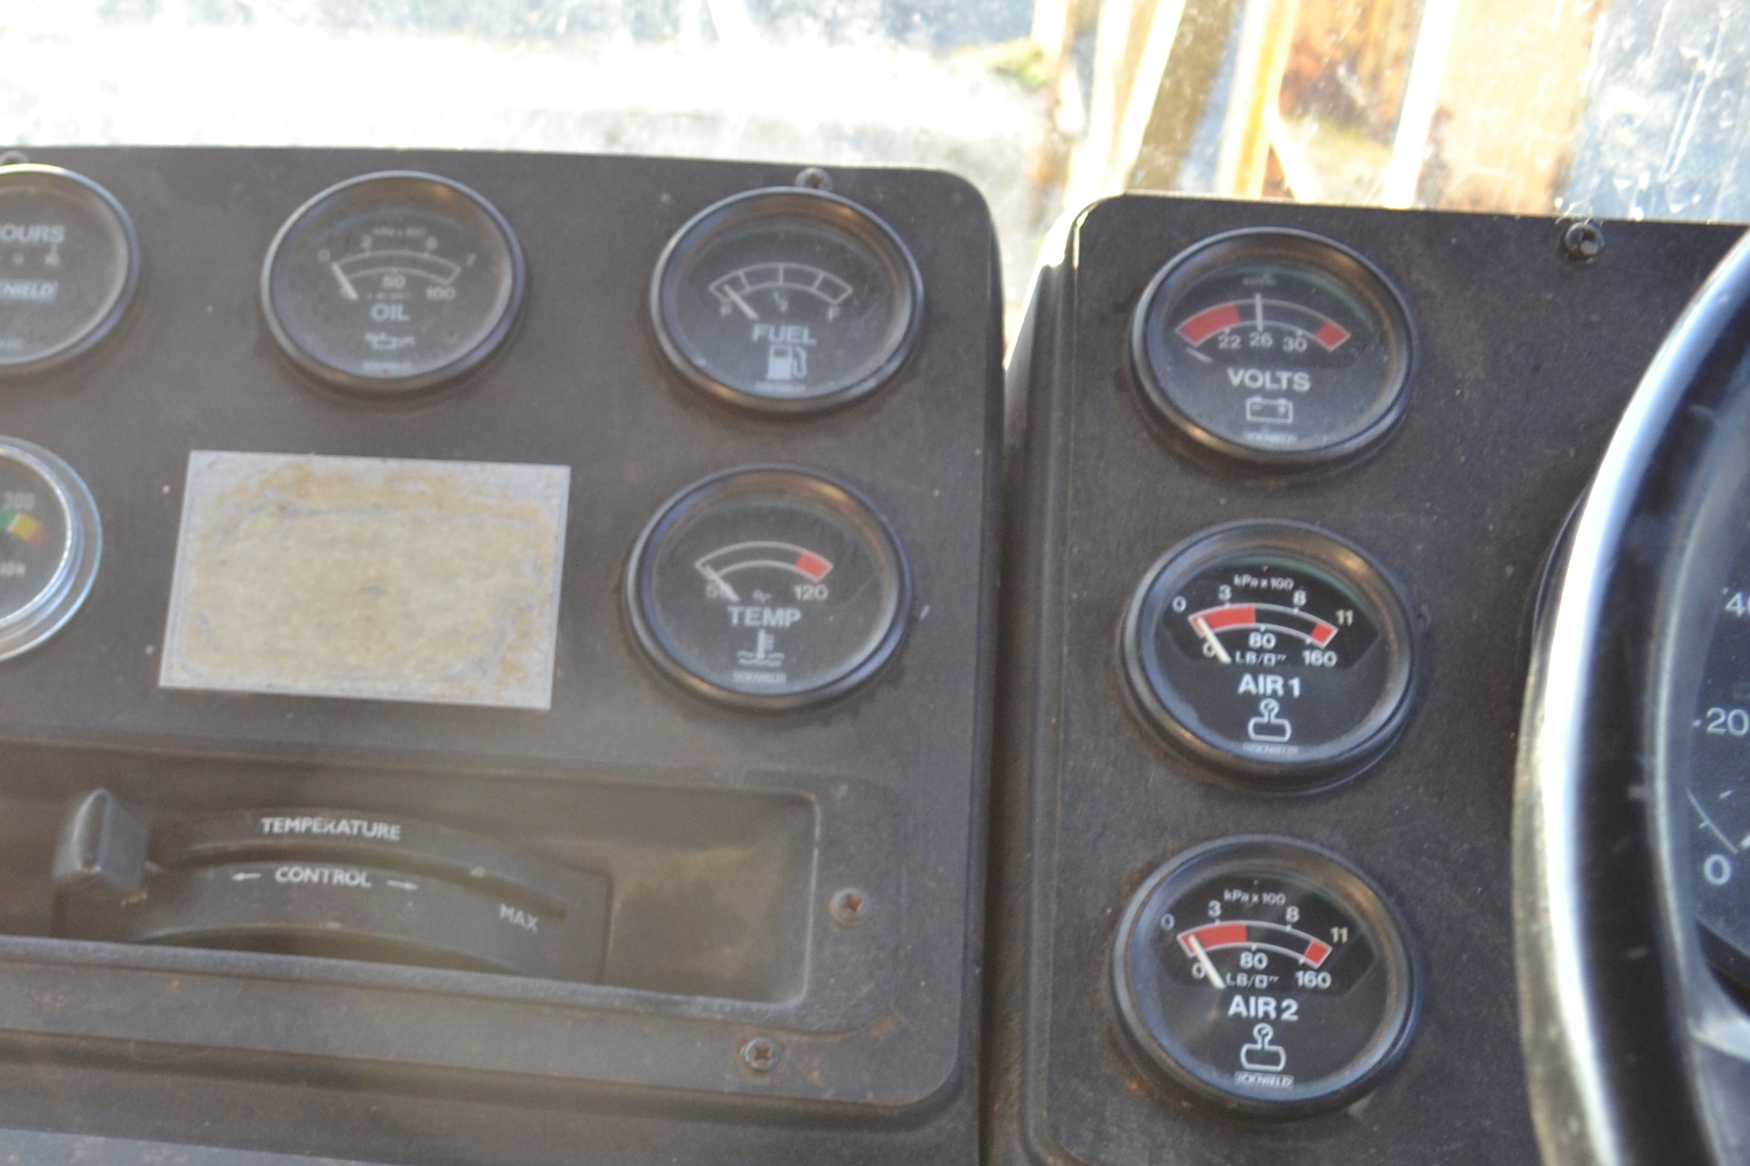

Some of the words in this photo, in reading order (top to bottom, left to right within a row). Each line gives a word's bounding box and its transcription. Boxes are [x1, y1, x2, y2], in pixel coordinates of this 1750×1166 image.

[381, 274, 407, 289] 50
[370, 302, 412, 322] OIL
[752, 322, 817, 346] FUEL
[1218, 333, 1242, 350] 22
[1248, 330, 1274, 349] 26
[1281, 335, 1309, 353] 30
[1226, 366, 1312, 392] VOLTS
[3, 491, 35, 511] 300
[792, 584, 829, 601] 120
[1269, 576, 1294, 591] 100
[728, 606, 802, 628] TEMP
[1172, 595, 1188, 613] 0
[1218, 585, 1233, 601] 3
[1334, 608, 1354, 626] 11
[1249, 632, 1277, 650] 80
[1302, 649, 1339, 669] 160
[1236, 673, 1285, 697] AIR
[1288, 677, 1302, 699] 1
[1706, 706, 1750, 737] 20
[260, 815, 403, 842] TEMPERATURE
[273, 865, 373, 891] CONTROL
[1702, 852, 1734, 888] 0
[1260, 890, 1287, 906] 100
[497, 902, 541, 935] MAX
[1160, 913, 1176, 930] 0
[1207, 900, 1222, 918] 3
[1284, 905, 1301, 924] 8
[1329, 926, 1350, 945] 11
[1239, 951, 1270, 971] 80
[1294, 970, 1333, 991] 160
[1226, 993, 1278, 1021] AIR
[1280, 997, 1300, 1022] 2
